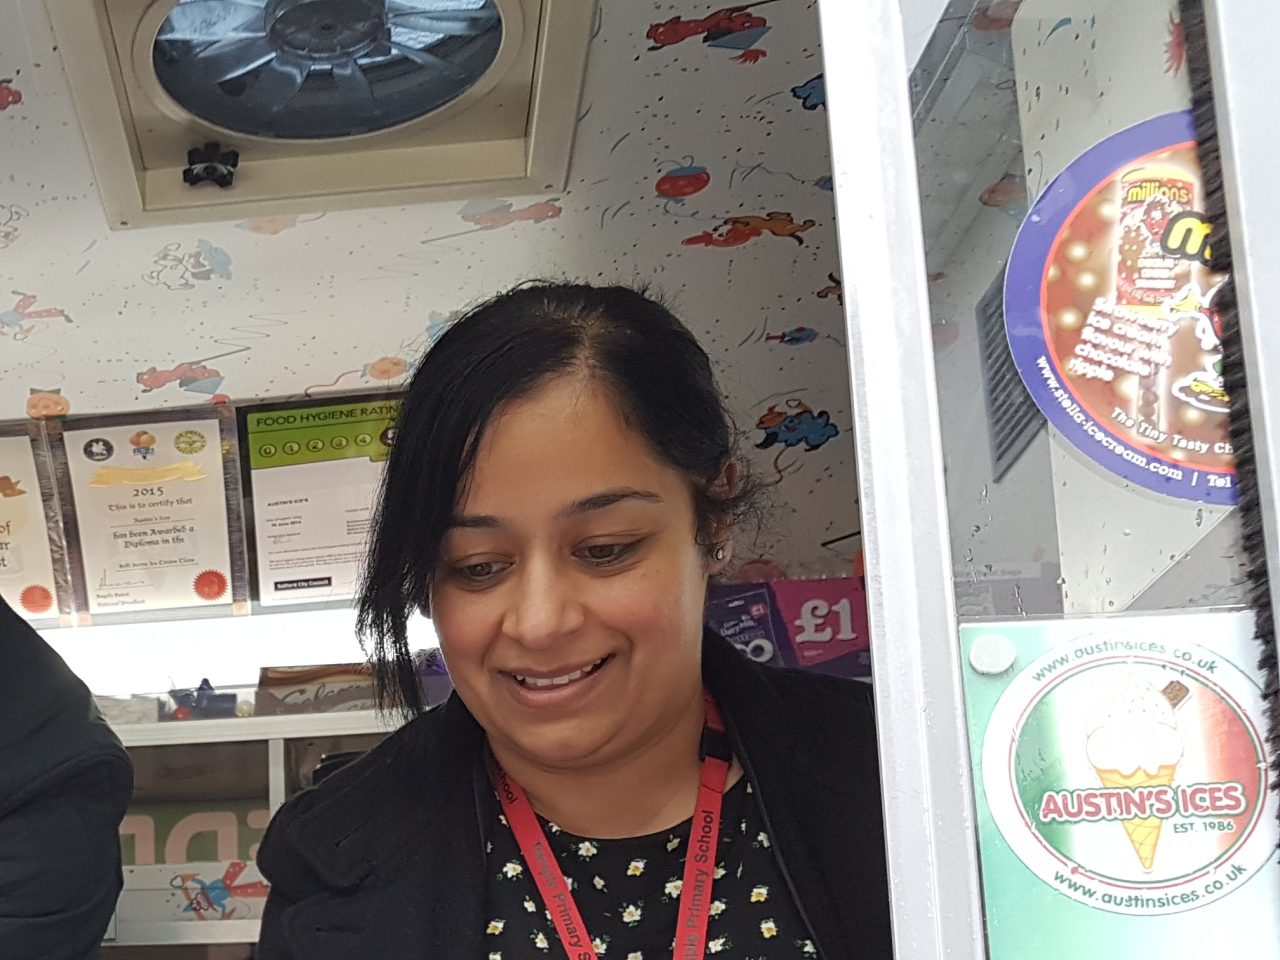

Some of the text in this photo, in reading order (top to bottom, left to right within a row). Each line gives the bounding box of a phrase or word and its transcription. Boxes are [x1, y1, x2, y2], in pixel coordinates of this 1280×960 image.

[1128, 182, 1189, 203] millions
[1074, 343, 1151, 377] chocolate
[1081, 326, 1173, 369] flavour with
[1068, 357, 1114, 381] ripple
[256, 406, 397, 427] FOOD HYGIENE RATIN
[1111, 408, 1135, 428] The
[1139, 422, 1167, 443] Tiny
[1172, 434, 1210, 455] Tasty
[108, 503, 127, 512] This
[148, 499, 174, 508] certify
[176, 497, 193, 505] that
[133, 487, 164, 497] 2015
[113, 532, 127, 540] has
[129, 529, 148, 538] been
[150, 526, 187, 537] Awarded
[124, 538, 159, 549] Diploma
[172, 536, 185, 544] the
[794, 598, 857, 643] £1
[1032, 638, 1219, 683] www.austinsices.co.uk
[1041, 785, 1242, 820] AUSTIN'S ICES
[695, 810, 714, 863] School
[1203, 820, 1235, 832] 1986
[533, 839, 558, 889] Temple
[553, 892, 582, 948] Primary
[685, 869, 709, 929] Primary
[1054, 864, 1247, 908] www.austinsices.co.uk
